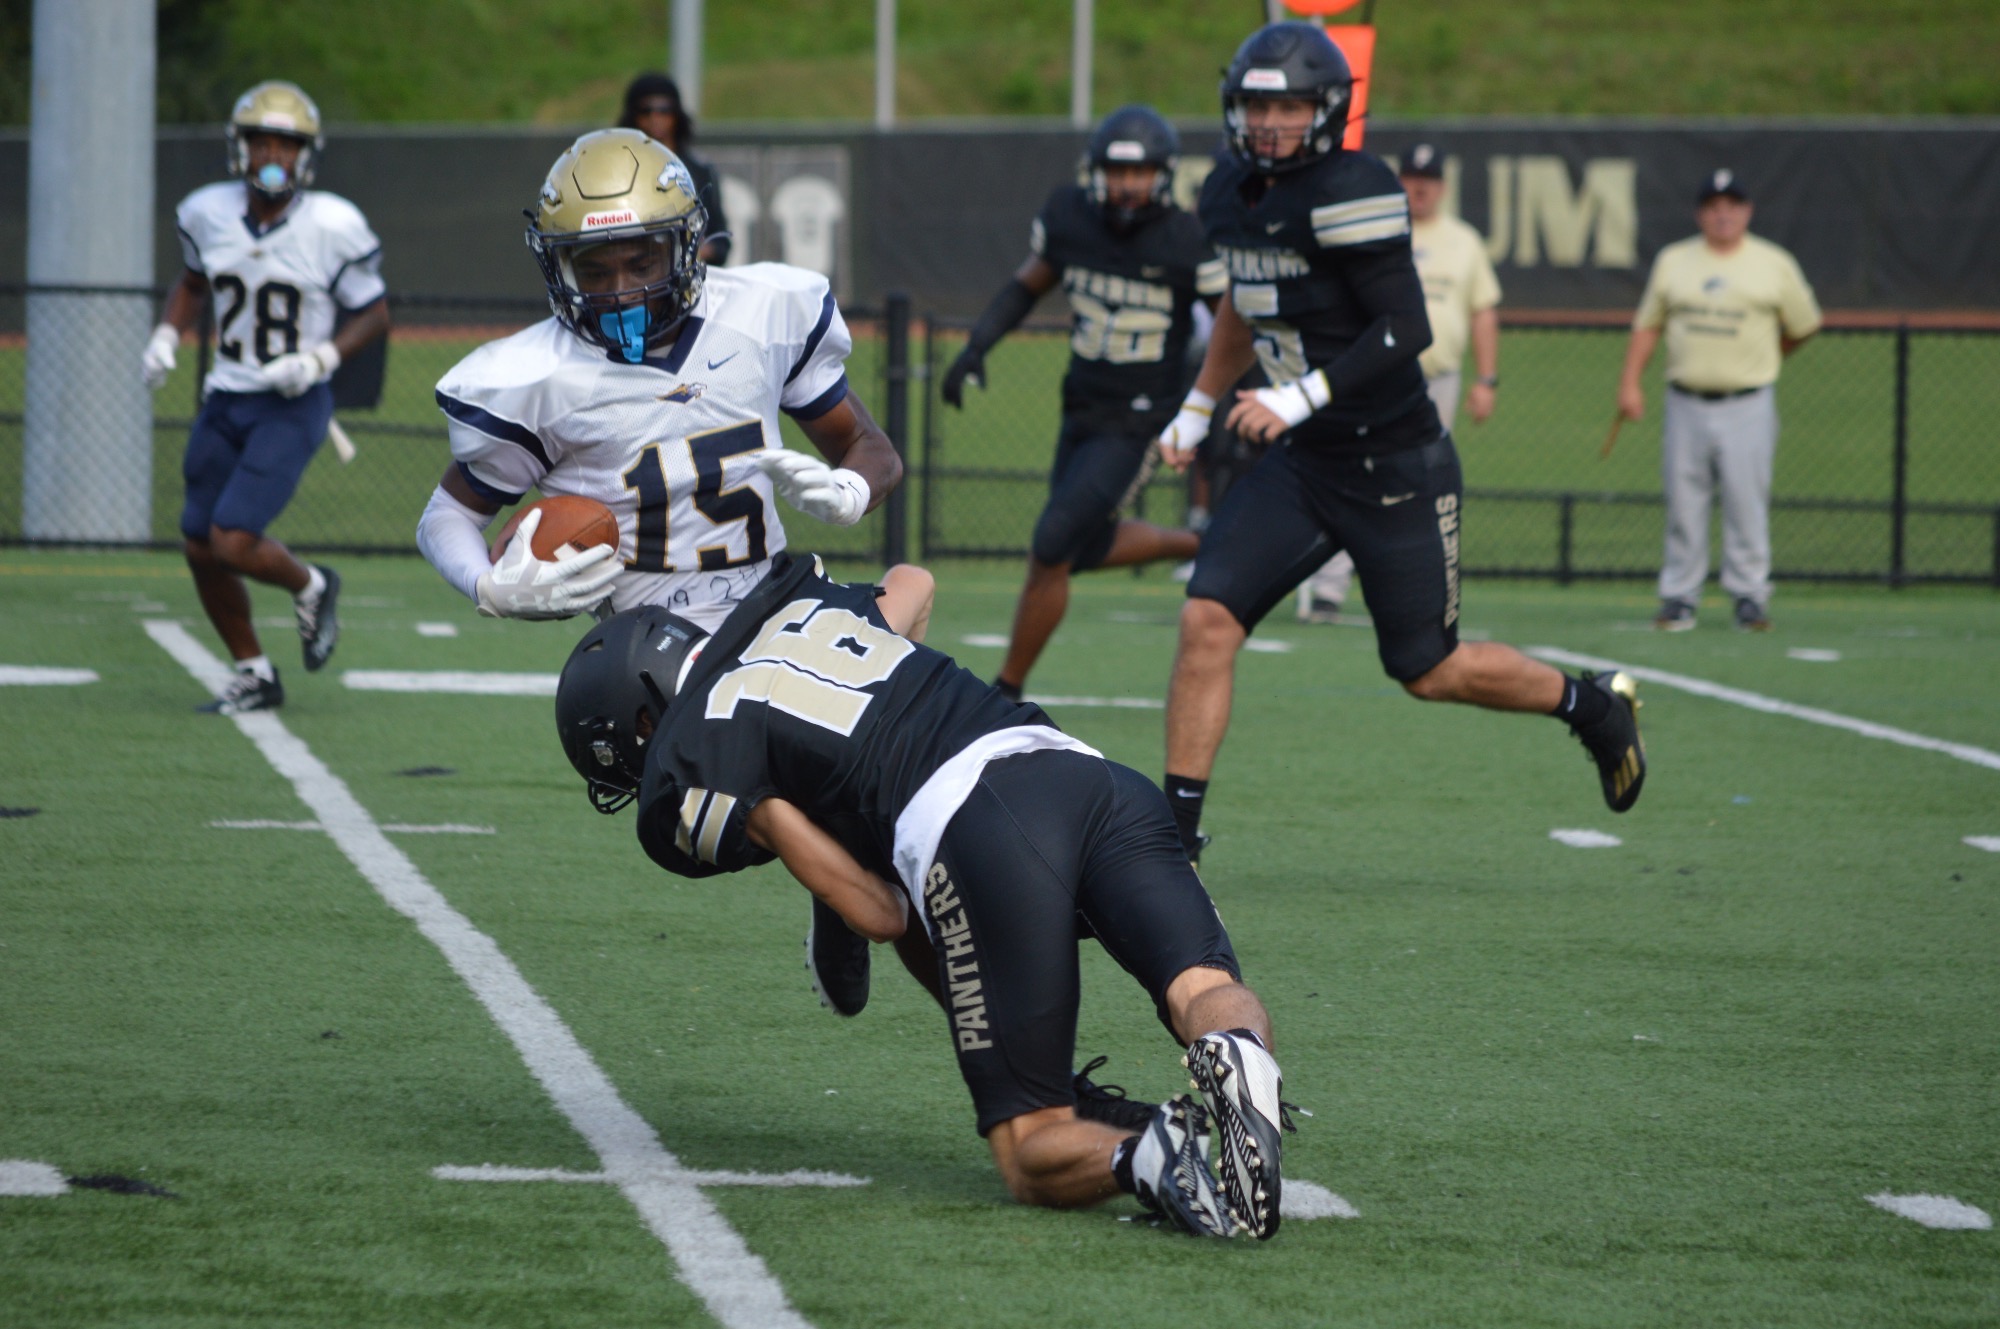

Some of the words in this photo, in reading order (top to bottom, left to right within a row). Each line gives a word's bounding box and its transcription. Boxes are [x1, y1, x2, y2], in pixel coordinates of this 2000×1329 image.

[586, 212, 633, 227] Riddell
[203, 273, 301, 369] 28
[1232, 282, 1310, 388] 5
[621, 417, 769, 574] 15
[704, 597, 917, 738] 16
[924, 861, 994, 1054] PANTHERS
